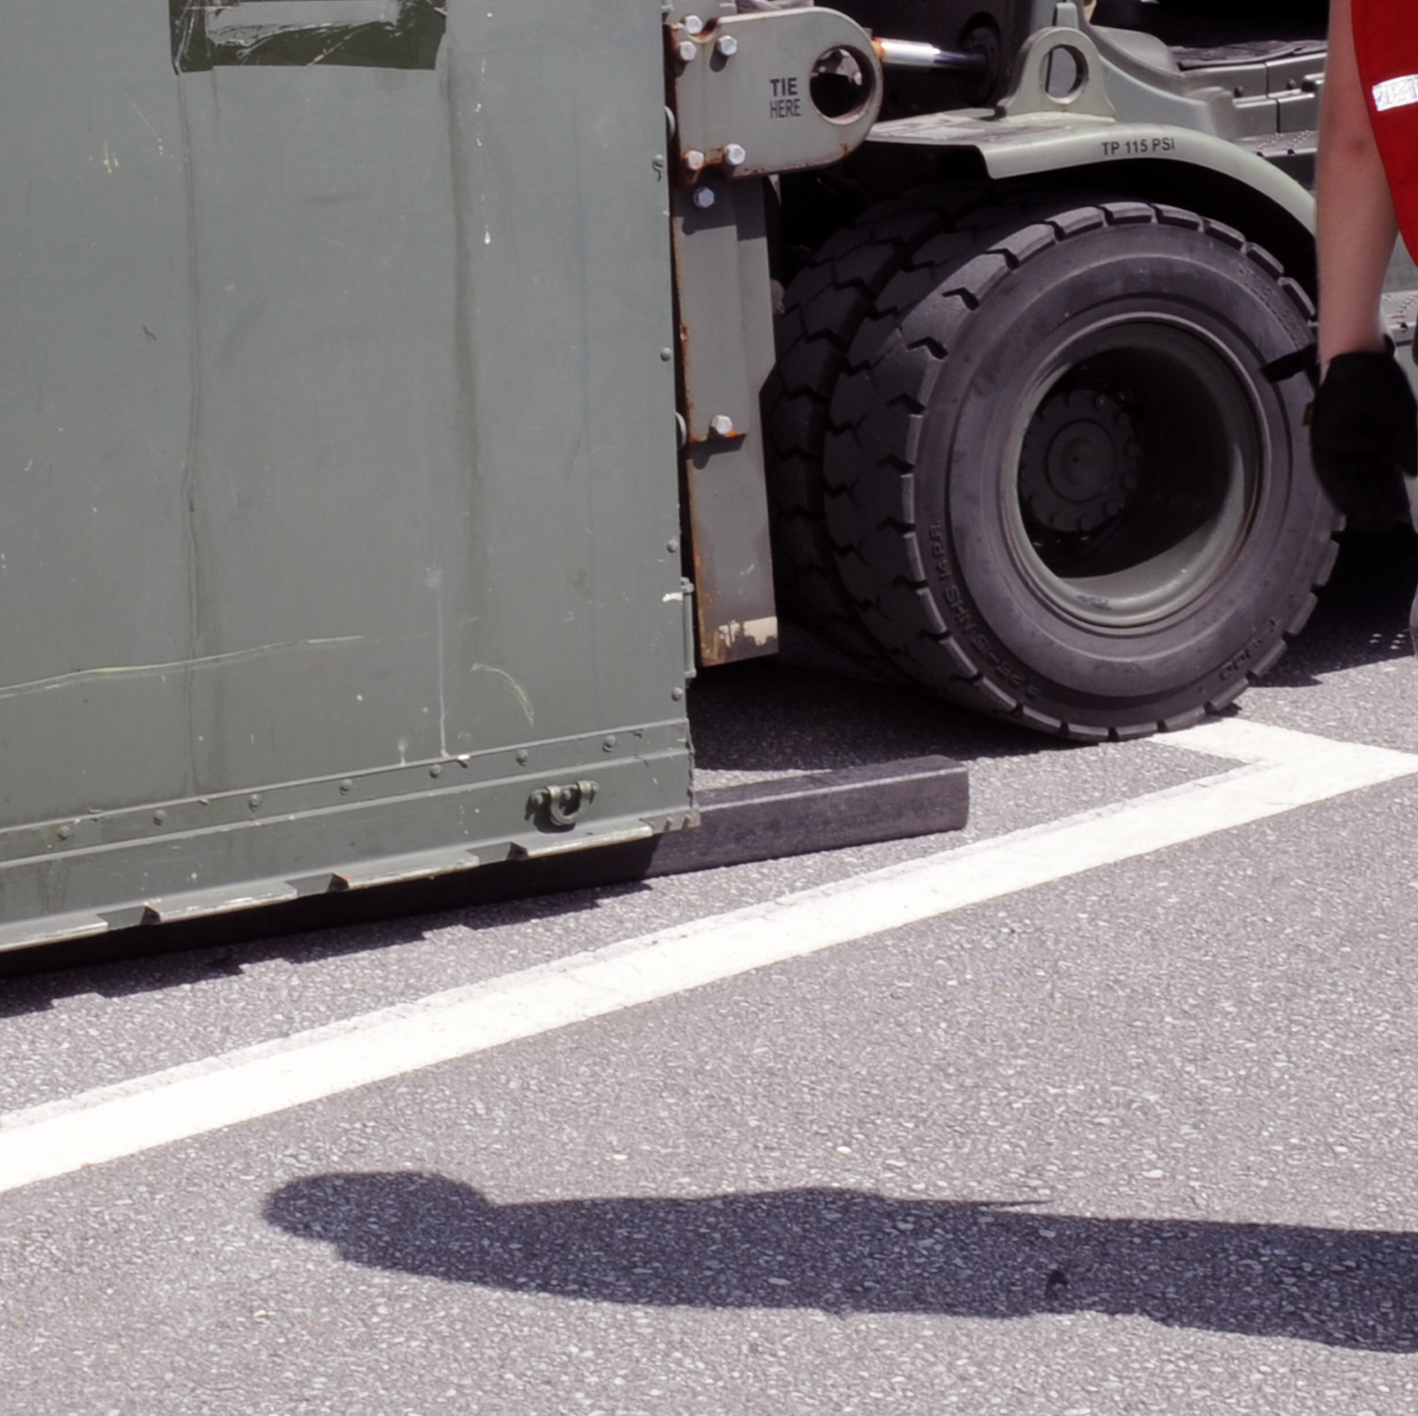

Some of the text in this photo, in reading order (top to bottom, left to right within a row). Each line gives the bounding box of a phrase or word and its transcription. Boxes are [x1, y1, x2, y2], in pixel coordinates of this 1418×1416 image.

[769, 77, 797, 97] TIE
[769, 98, 802, 119] HERE
[1101, 137, 1175, 156] TP 115 PSI
